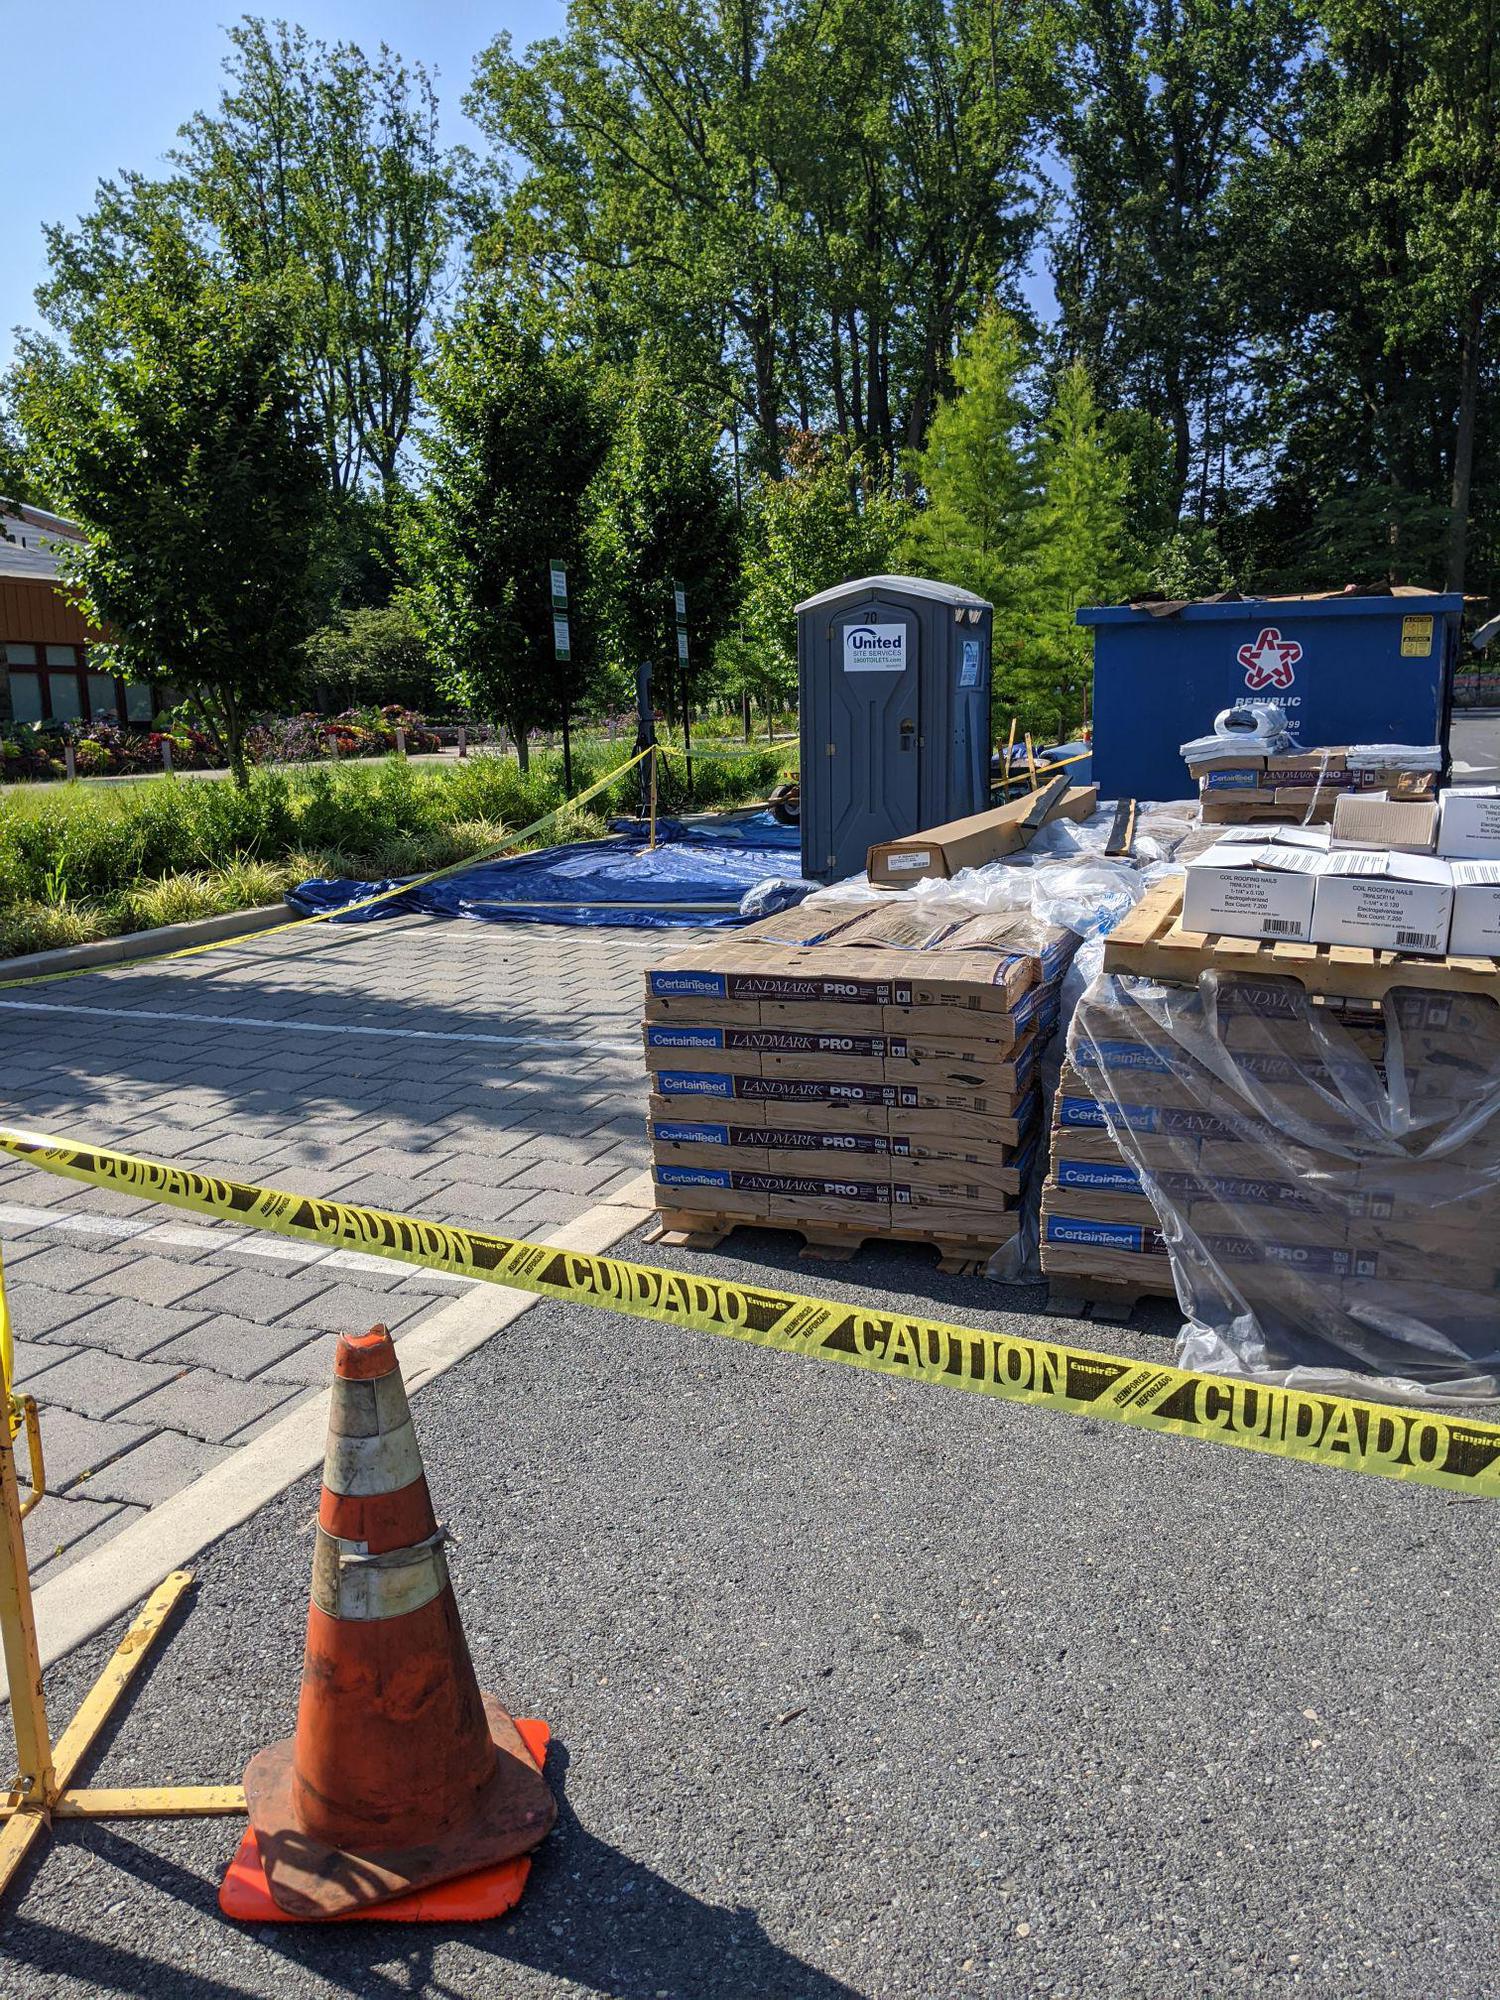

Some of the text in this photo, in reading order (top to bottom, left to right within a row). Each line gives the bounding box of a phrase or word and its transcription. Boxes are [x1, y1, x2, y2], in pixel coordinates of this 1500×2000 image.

[863, 612, 877, 624] 70
[852, 635, 902, 649] United
[1235, 697, 1302, 707] REPUBLIC
[1211, 773, 1253, 782] CertainTeed
[1263, 771, 1314, 779] LANDMARK
[1225, 895, 1269, 903] Electrogalvanized
[656, 977, 719, 991] CertainTeed
[735, 979, 818, 994] LANDMARK
[823, 983, 858, 995] PRO
[653, 1034, 717, 1047] CertainTeed
[732, 1034, 813, 1048] LANDMARK
[819, 1038, 853, 1050] PRO
[664, 1078, 726, 1091] CertainTeed
[742, 1081, 823, 1095] LANDMARK
[830, 1086, 864, 1098] PRO
[660, 1130, 722, 1143] CertainTeed
[737, 1132, 816, 1146] LANDMARK
[822, 1137, 856, 1148] PRO
[94, 1154, 233, 1207] CUIDADO
[663, 1173, 724, 1186] CertainTeed
[739, 1175, 818, 1192] LANDMARK
[824, 1184, 858, 1195] PRO
[1065, 1170, 1140, 1184] CertainTee
[310, 1201, 474, 1266] CAUTION
[1054, 1226, 1132, 1244] CertainTeed
[1264, 1246, 1308, 1261] PRO
[564, 1254, 749, 1328] CUIDADO
[784, 1305, 813, 1336] REINFORCED
[802, 1310, 831, 1338] REFORZADO
[853, 1314, 1067, 1397] CAUTION
[1070, 1361, 1117, 1377] Empire
[1113, 1370, 1152, 1405] REINFORCED
[1135, 1375, 1173, 1408] REFORZADO
[1194, 1379, 1450, 1471] CUIDADO
